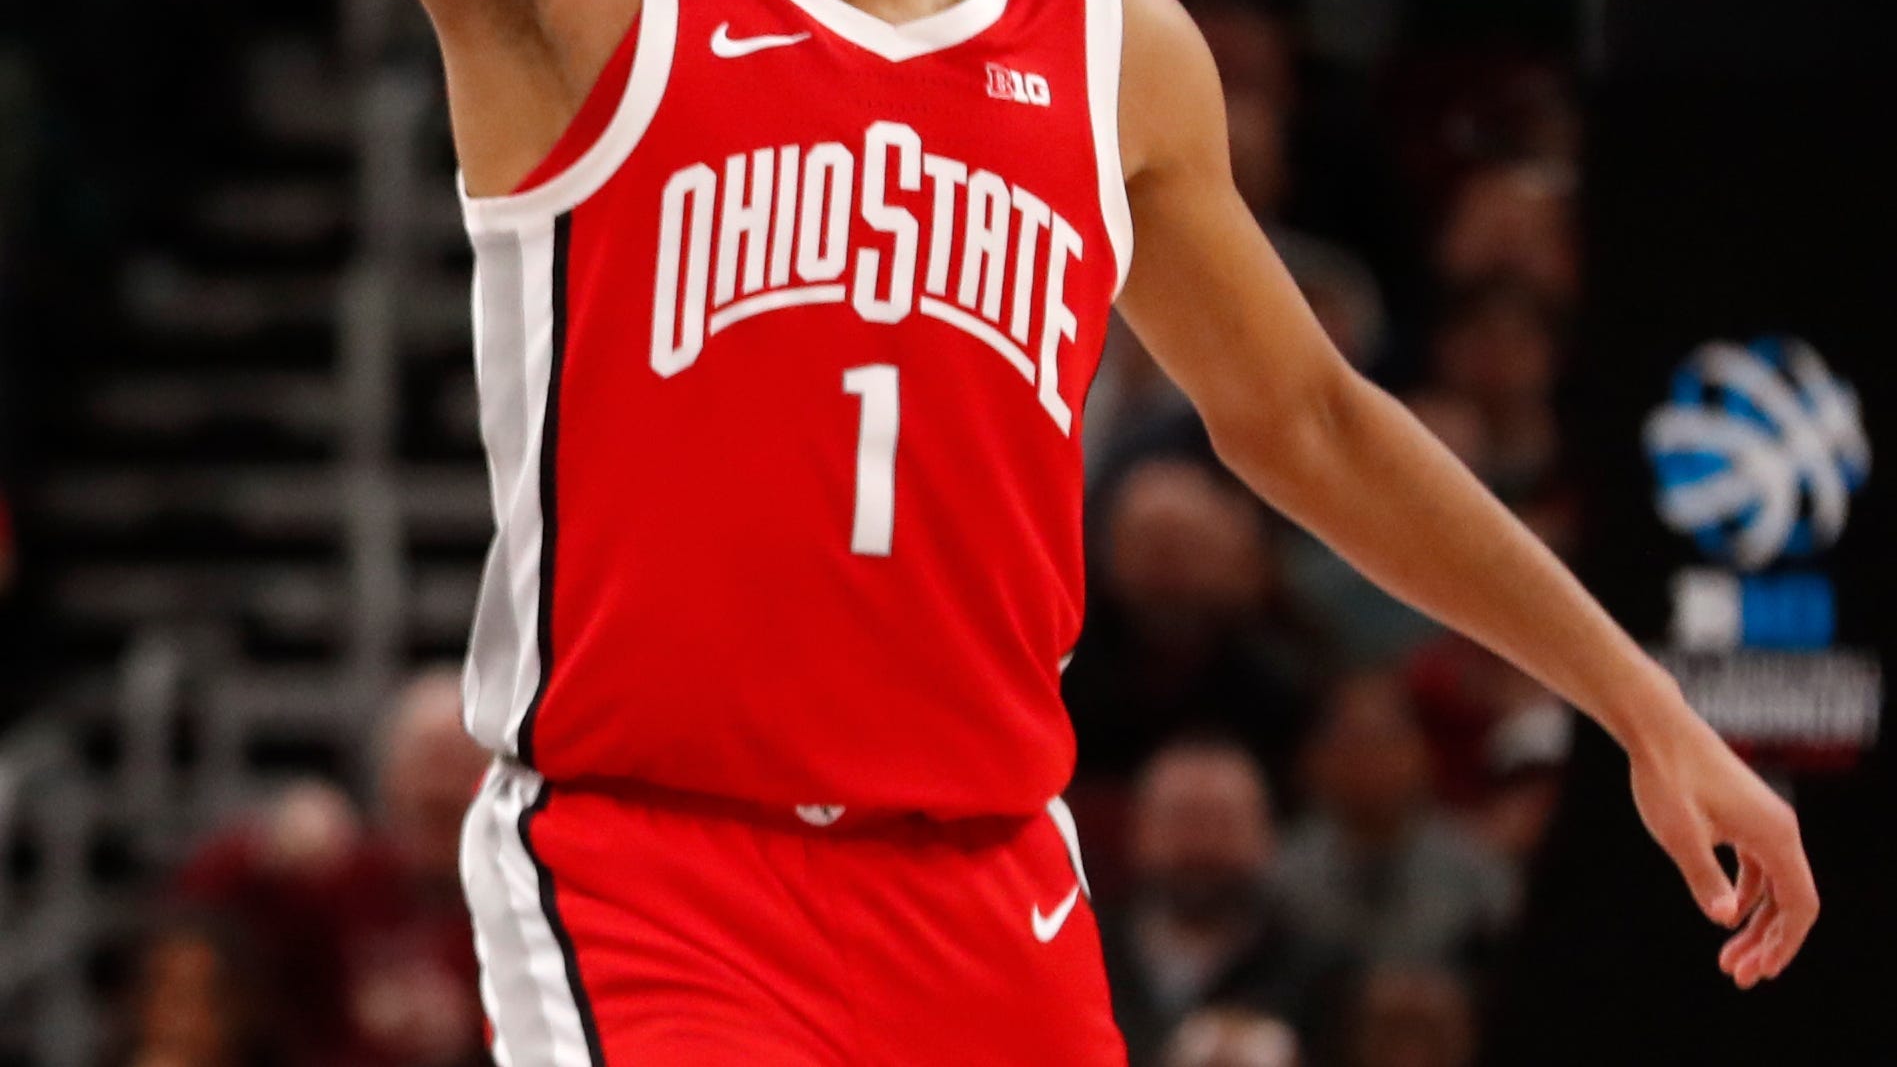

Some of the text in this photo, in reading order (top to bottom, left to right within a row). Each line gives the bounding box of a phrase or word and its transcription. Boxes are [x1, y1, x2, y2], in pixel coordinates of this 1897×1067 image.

[650, 120, 1084, 437] OHIO STATE
[842, 363, 900, 556] 1
